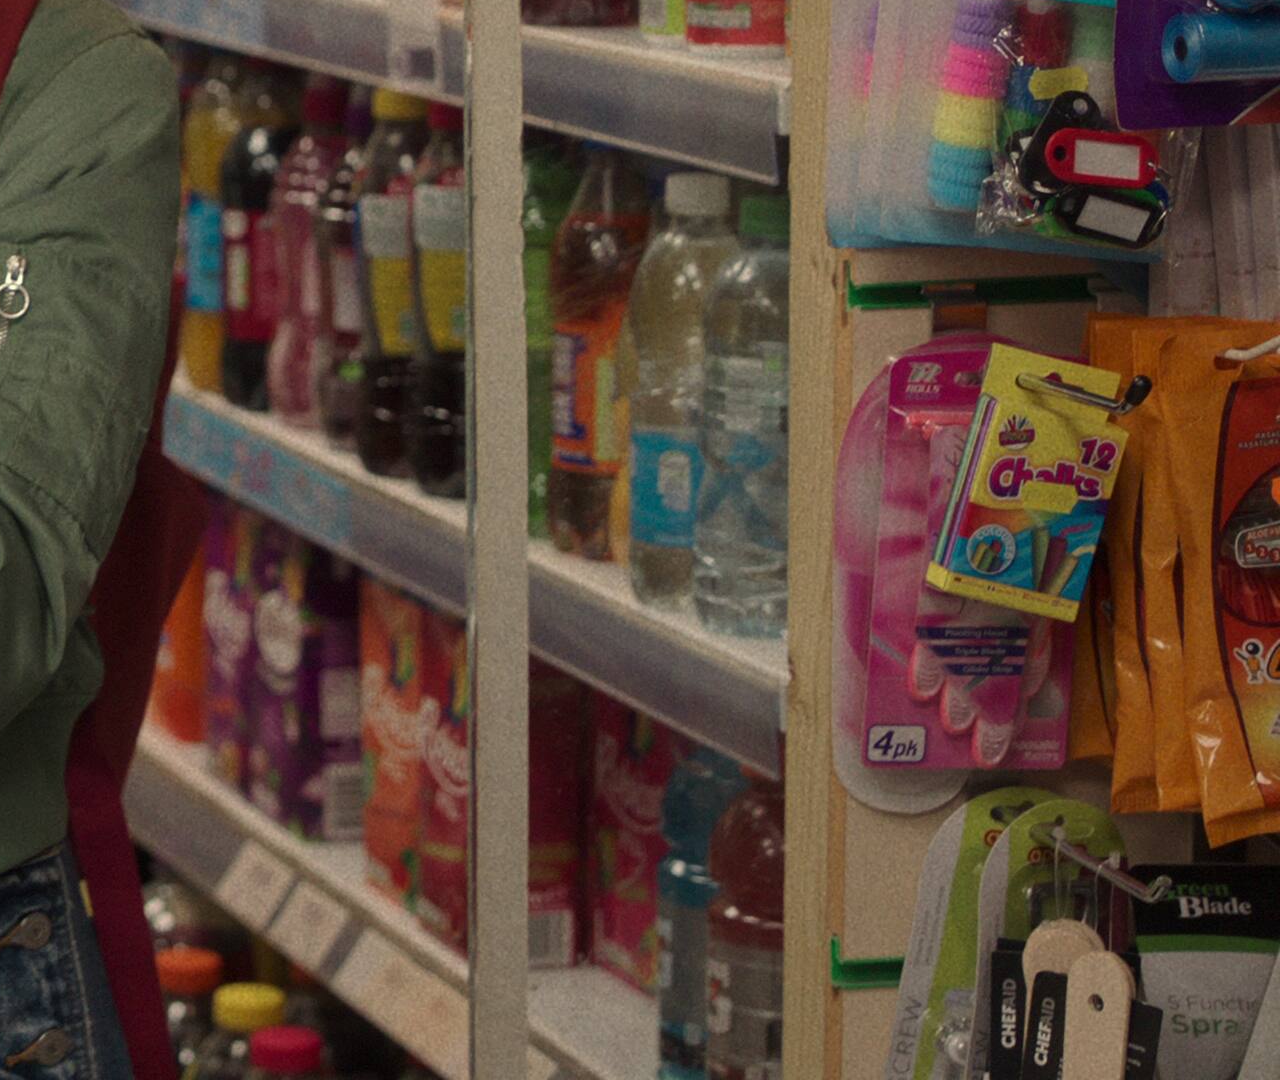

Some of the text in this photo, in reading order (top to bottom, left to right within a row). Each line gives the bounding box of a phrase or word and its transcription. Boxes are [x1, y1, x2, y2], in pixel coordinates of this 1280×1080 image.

[1080, 438, 1118, 472] 12
[873, 730, 918, 758] 4pk
[1166, 882, 1230, 900] reen
[1179, 896, 1252, 919] Blade
[1001, 978, 1017, 1049] CHEFAID
[1033, 997, 1056, 1067] CHEFAID
